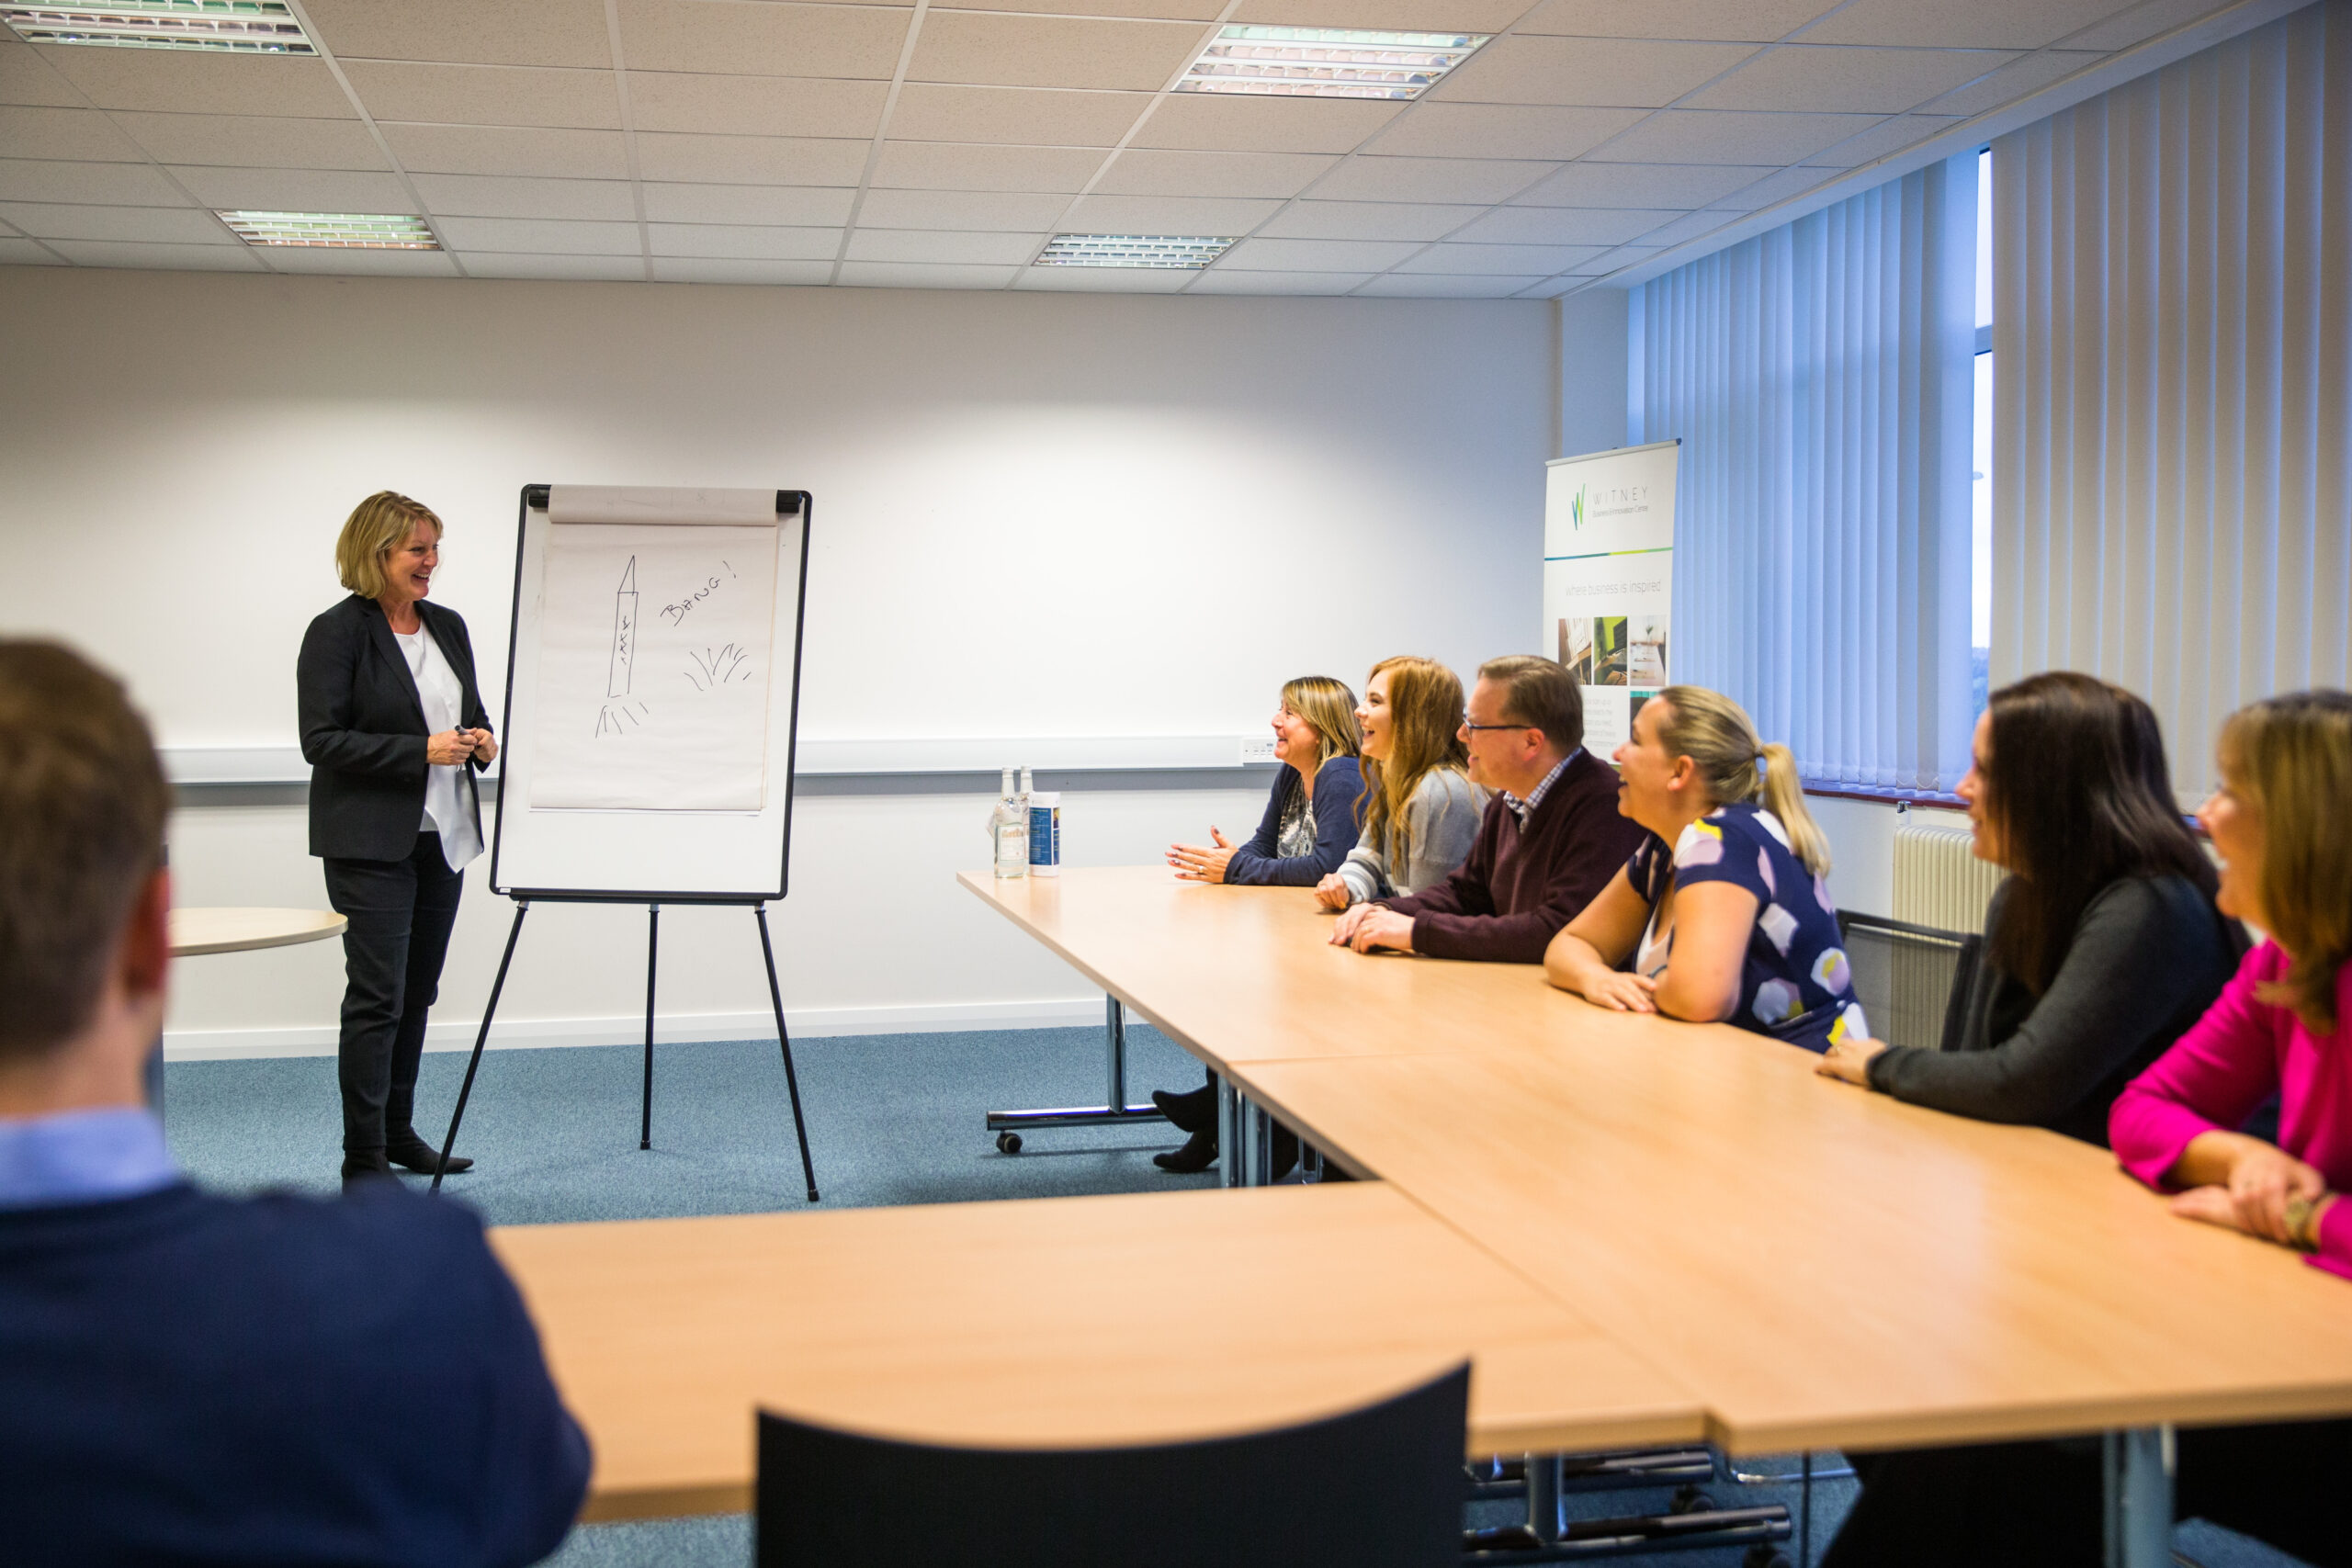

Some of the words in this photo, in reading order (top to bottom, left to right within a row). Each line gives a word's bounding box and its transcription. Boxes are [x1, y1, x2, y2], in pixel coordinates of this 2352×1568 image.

[1592, 486, 1648, 505] WITNEY
[1565, 582, 1587, 596] where
[1588, 581, 1619, 595] business
[1621, 581, 1627, 594] is
